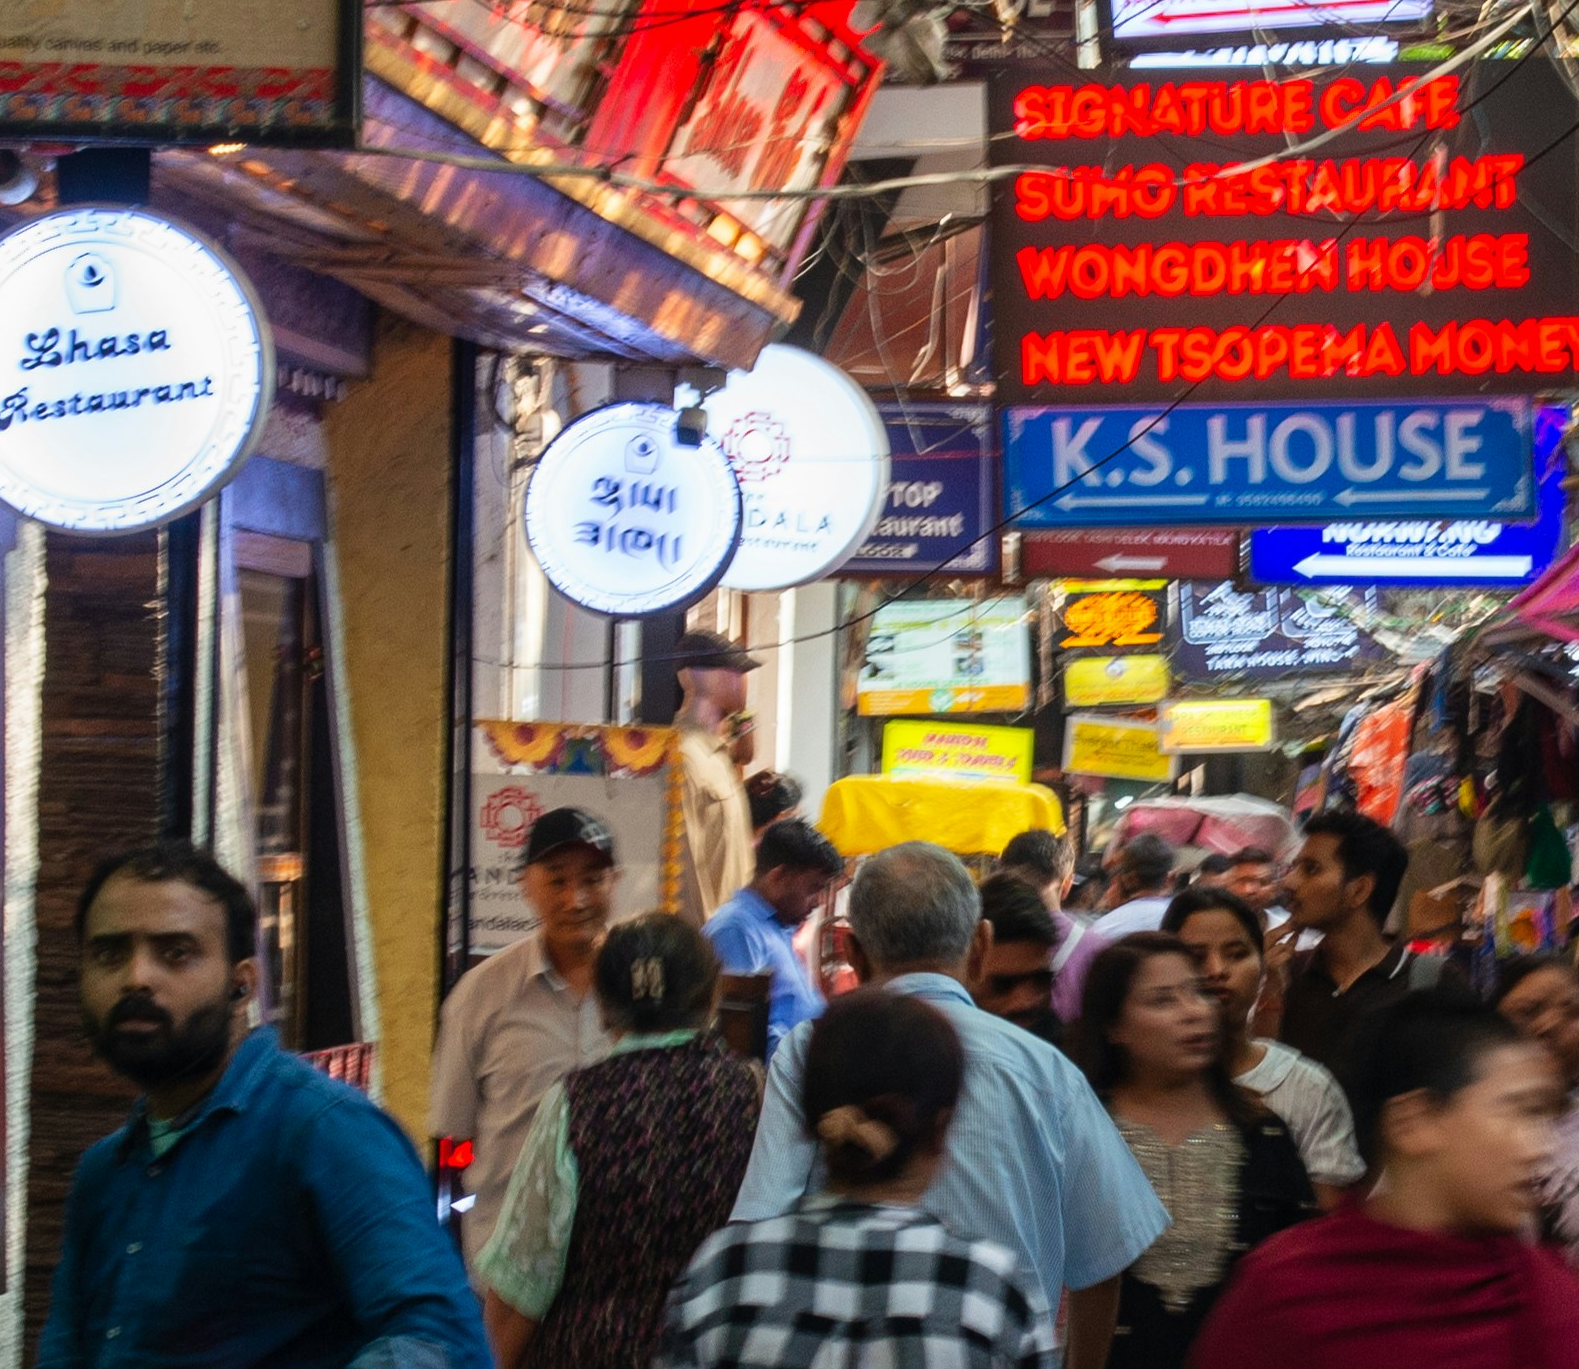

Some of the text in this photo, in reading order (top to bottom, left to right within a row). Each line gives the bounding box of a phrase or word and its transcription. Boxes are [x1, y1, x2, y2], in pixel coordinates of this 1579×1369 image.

[1014, 79, 1315, 141] SIGNATURE
[1014, 153, 1526, 222] SUMO RESTAURANT
[1016, 238, 1338, 301] WONGDHEN
[1346, 233, 1531, 293] HOUSE
[19, 325, 173, 371] Lhasa
[1020, 328, 1149, 386] NEW
[1149, 320, 1407, 382] TSOPEMA
[1050, 408, 1488, 489] K.S. HOUSE
[746, 507, 833, 535] DALA
